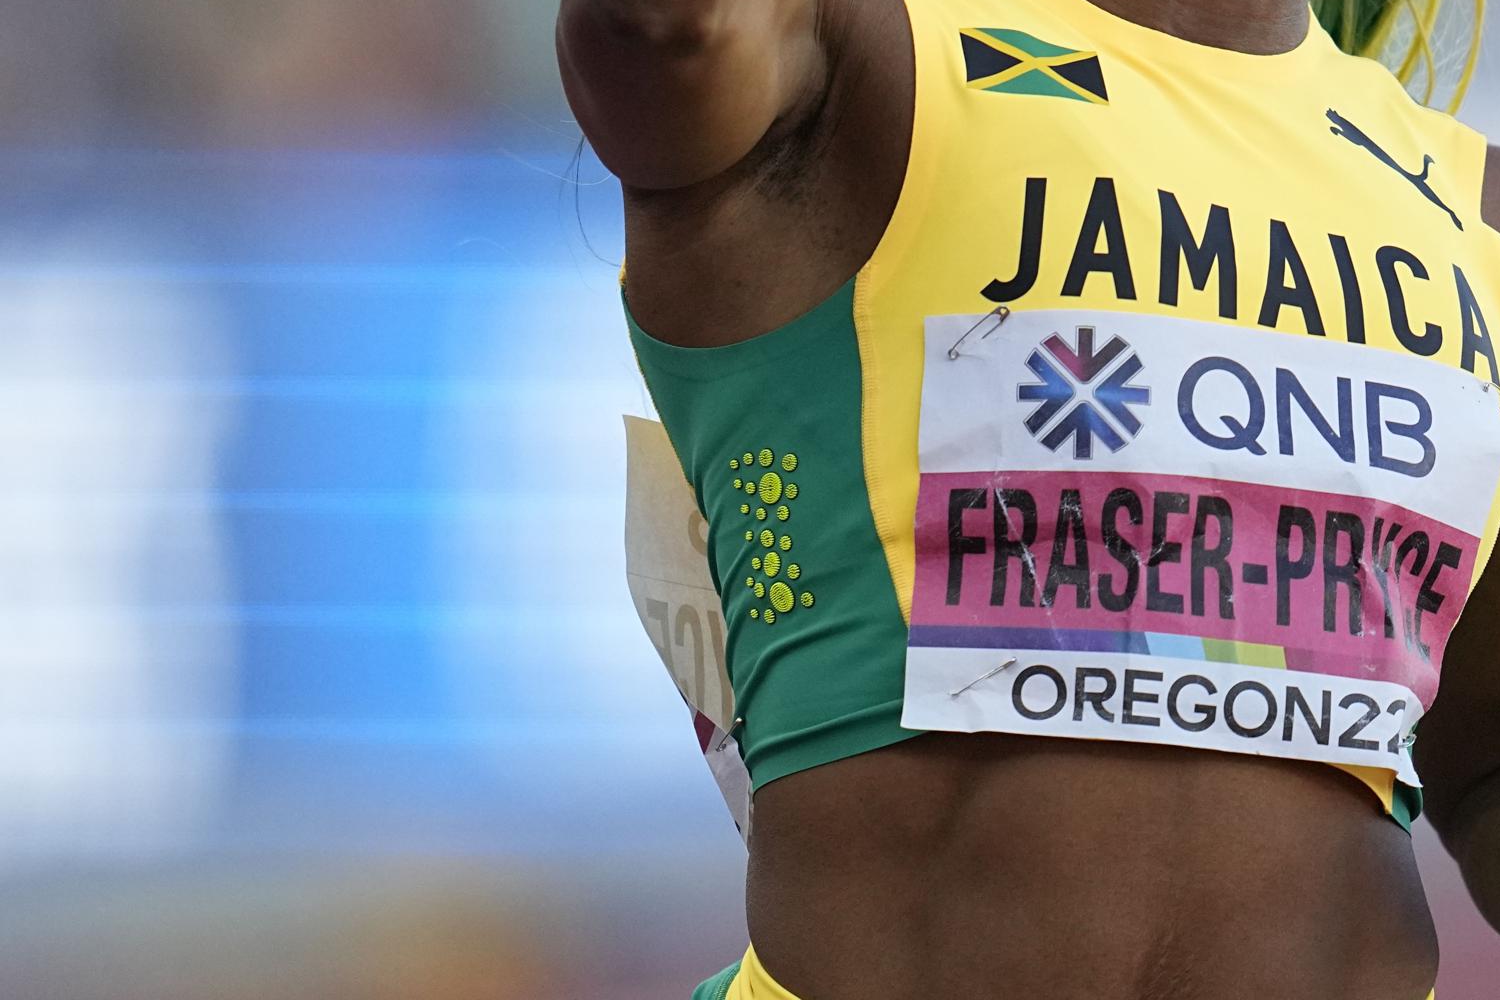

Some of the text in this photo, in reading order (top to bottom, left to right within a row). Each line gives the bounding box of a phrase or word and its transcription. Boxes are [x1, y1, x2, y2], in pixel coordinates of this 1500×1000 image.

[980, 177, 1500, 387] JAMAICA
[1177, 356, 1437, 478] QNB
[944, 487, 1462, 664] FRASER-PRYCE
